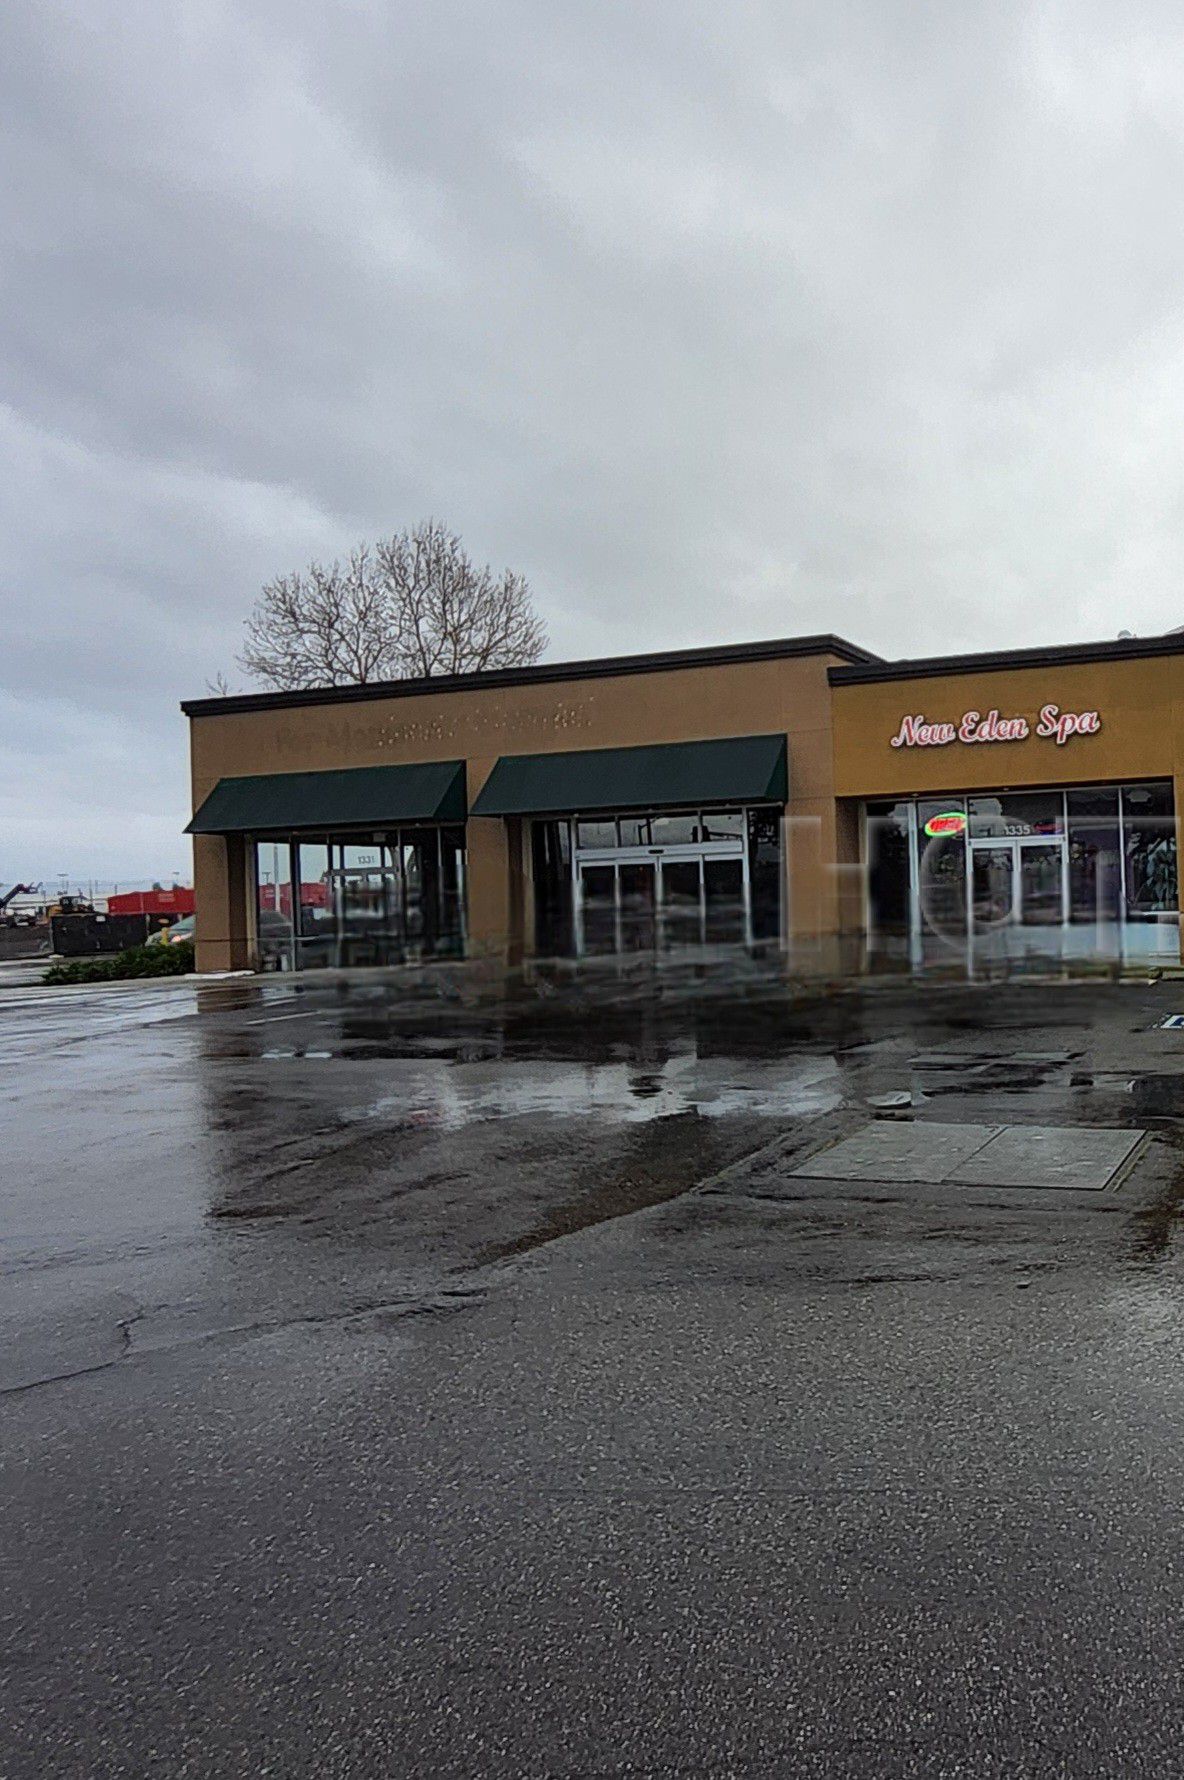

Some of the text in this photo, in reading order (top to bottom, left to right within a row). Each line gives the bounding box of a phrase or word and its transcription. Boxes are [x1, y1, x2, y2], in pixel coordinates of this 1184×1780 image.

[890, 704, 1101, 747] New Eden Spa
